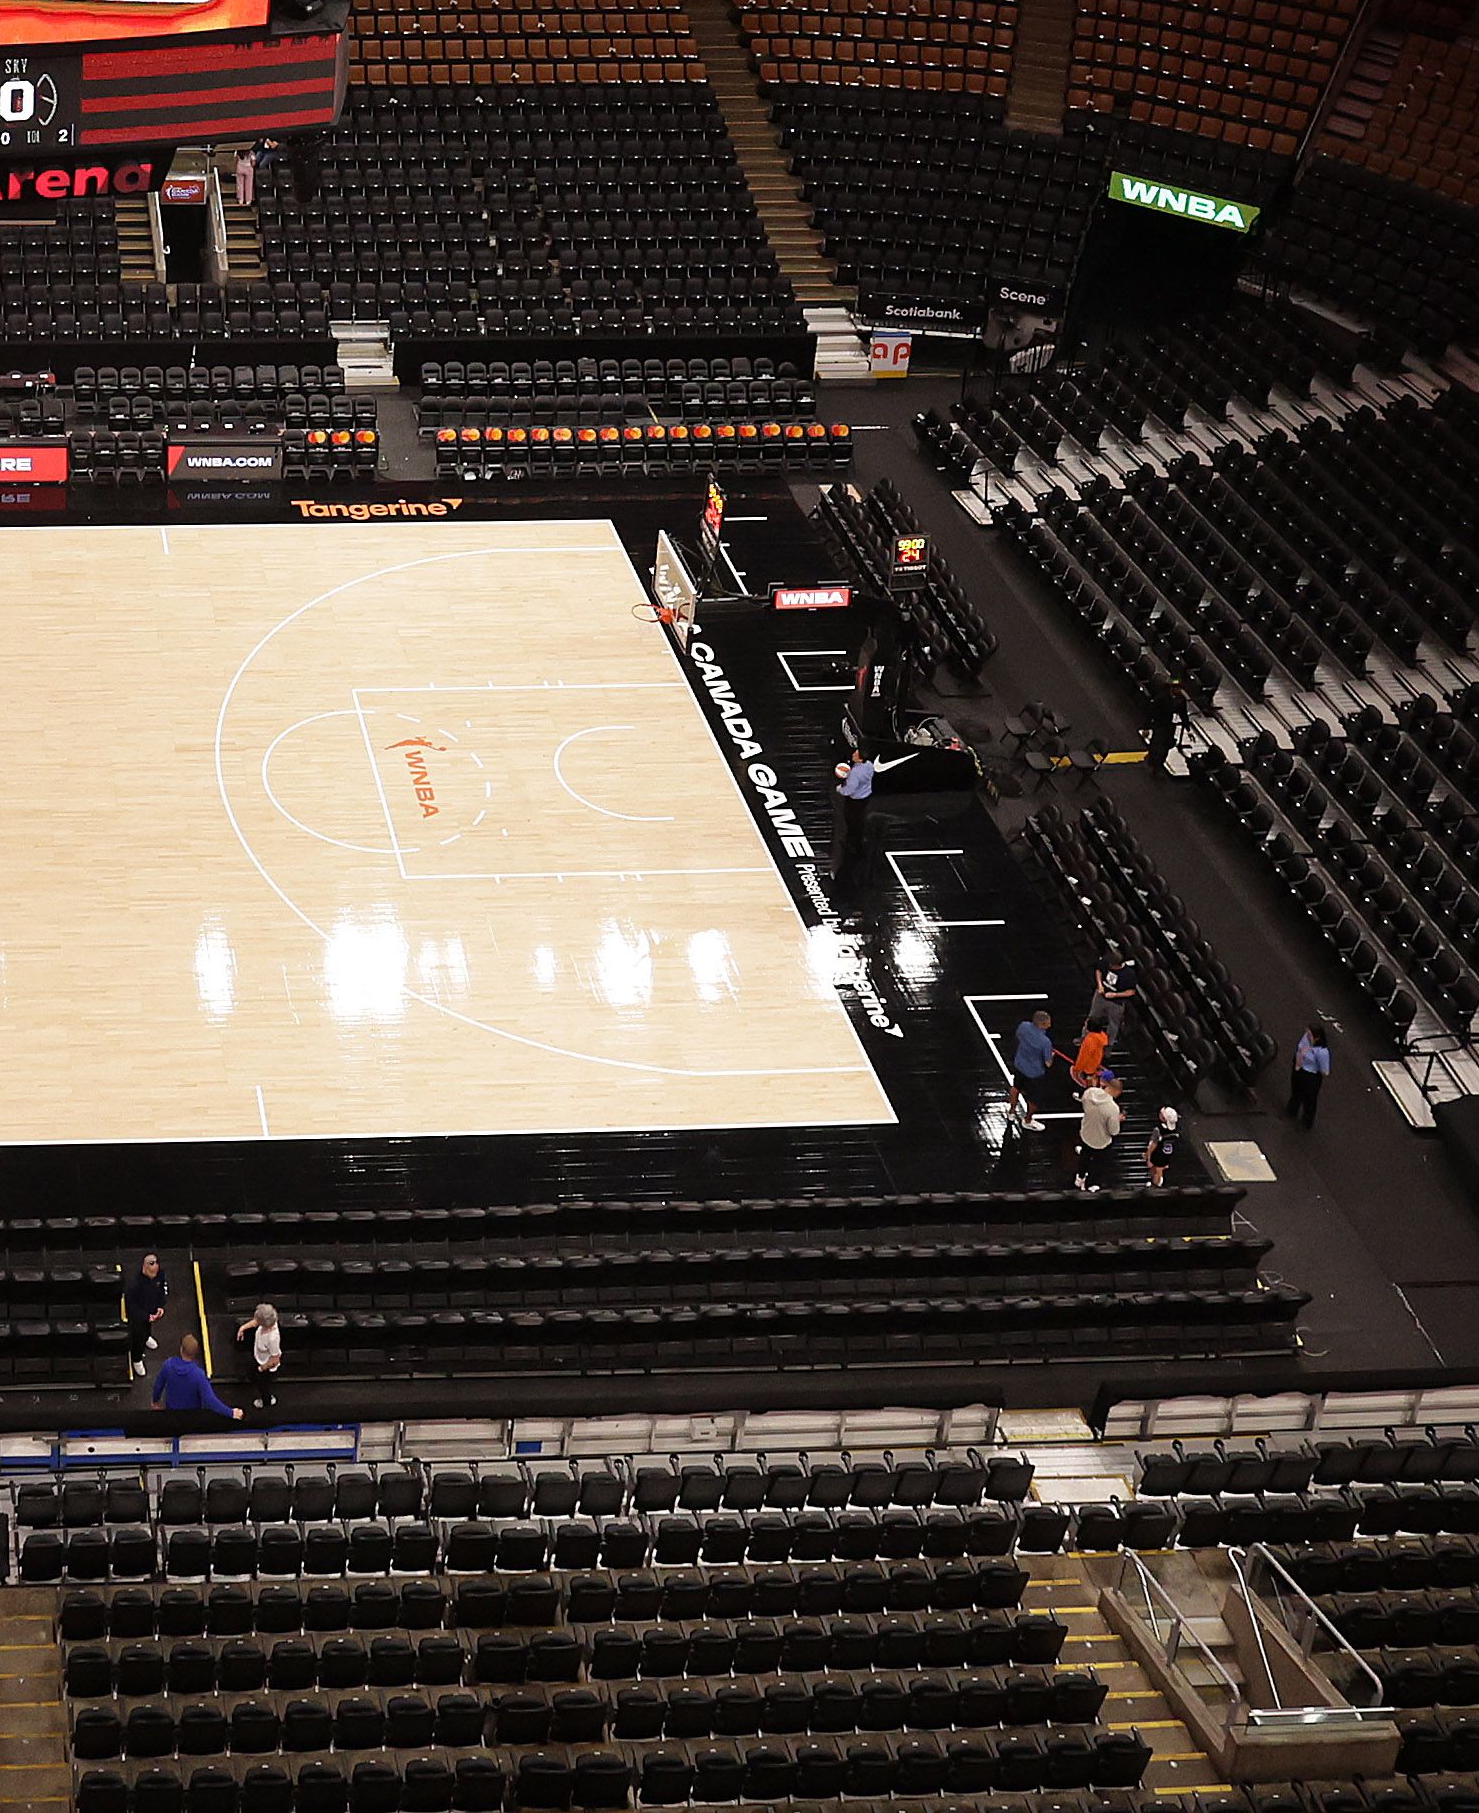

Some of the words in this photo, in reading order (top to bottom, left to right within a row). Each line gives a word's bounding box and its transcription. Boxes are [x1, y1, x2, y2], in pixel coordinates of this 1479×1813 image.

[4, 58, 28, 74] SKY
[58, 128, 69, 143] 2
[1121, 177, 1245, 228] WNBA
[999, 287, 1047, 305] Scene
[186, 455, 272, 468] WNBA.COM
[292, 499, 448, 521] Tangerine
[902, 549, 920, 563] 24
[780, 590, 844, 606] WNBA
[404, 749, 439, 820] WNBA
[690, 642, 762, 762] CANADA
[745, 763, 815, 859] GAME
[795, 863, 839, 917] Presented
